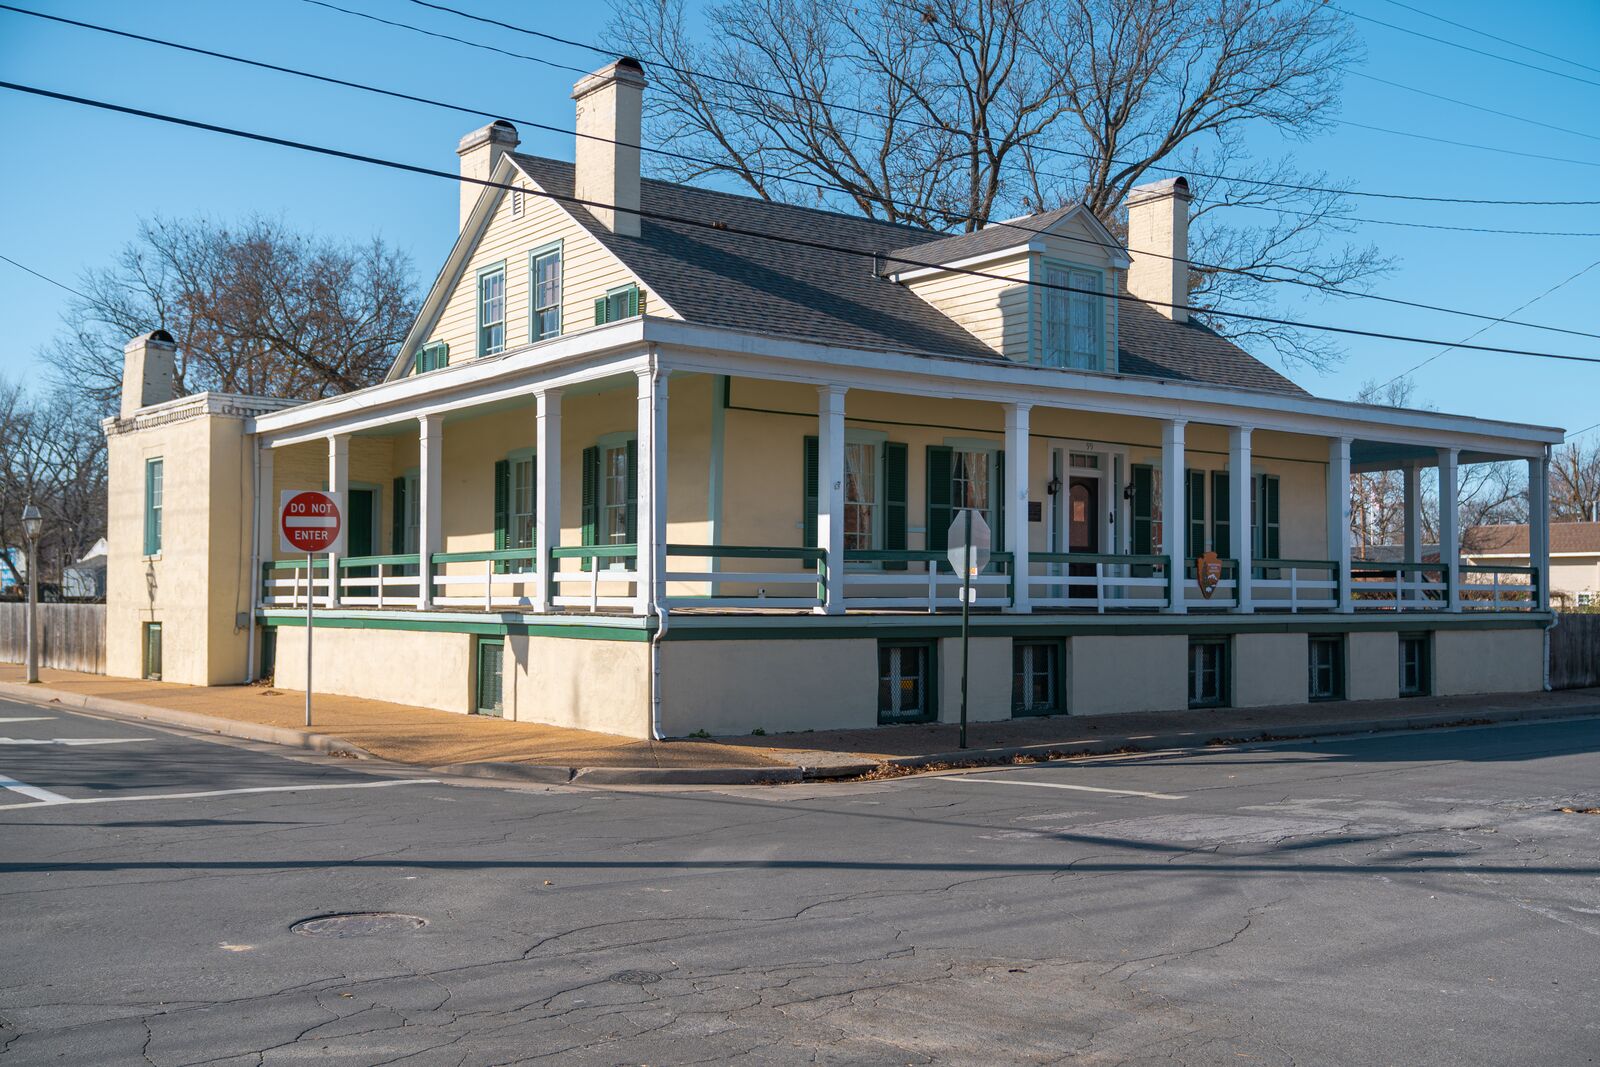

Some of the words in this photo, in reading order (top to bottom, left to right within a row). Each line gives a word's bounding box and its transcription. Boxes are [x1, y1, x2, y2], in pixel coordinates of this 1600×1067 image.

[291, 503, 305, 513] DO
[312, 504, 332, 513] NOT
[295, 531, 328, 540] ENTER
